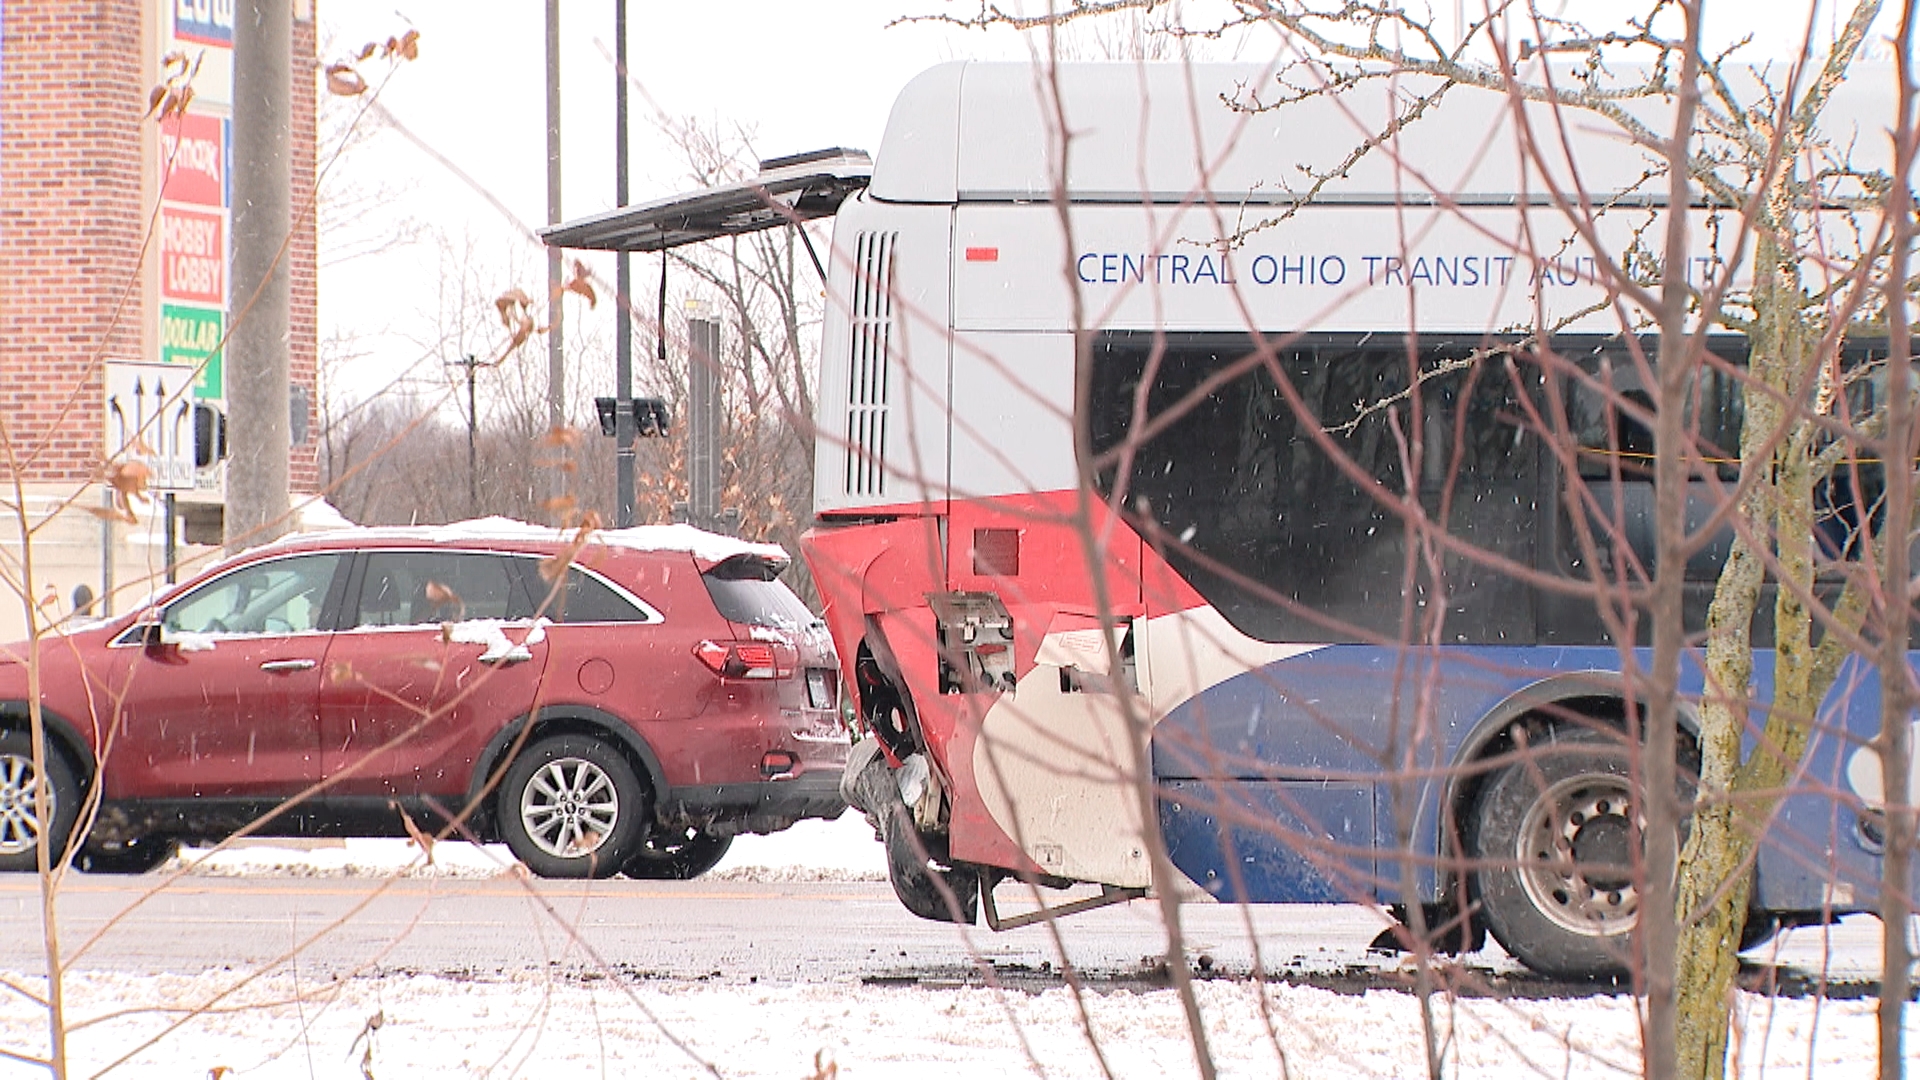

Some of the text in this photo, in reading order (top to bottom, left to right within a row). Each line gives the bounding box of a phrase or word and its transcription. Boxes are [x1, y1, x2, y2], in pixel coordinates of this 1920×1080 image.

[161, 215, 217, 257] HOBBY
[168, 255, 222, 296] LOBBY
[1077, 252, 1237, 285] CENTRAL
[1251, 254, 1346, 286] OHIO
[1361, 256, 1514, 287] TRANSIT
[161, 316, 218, 353] DOLLAR
